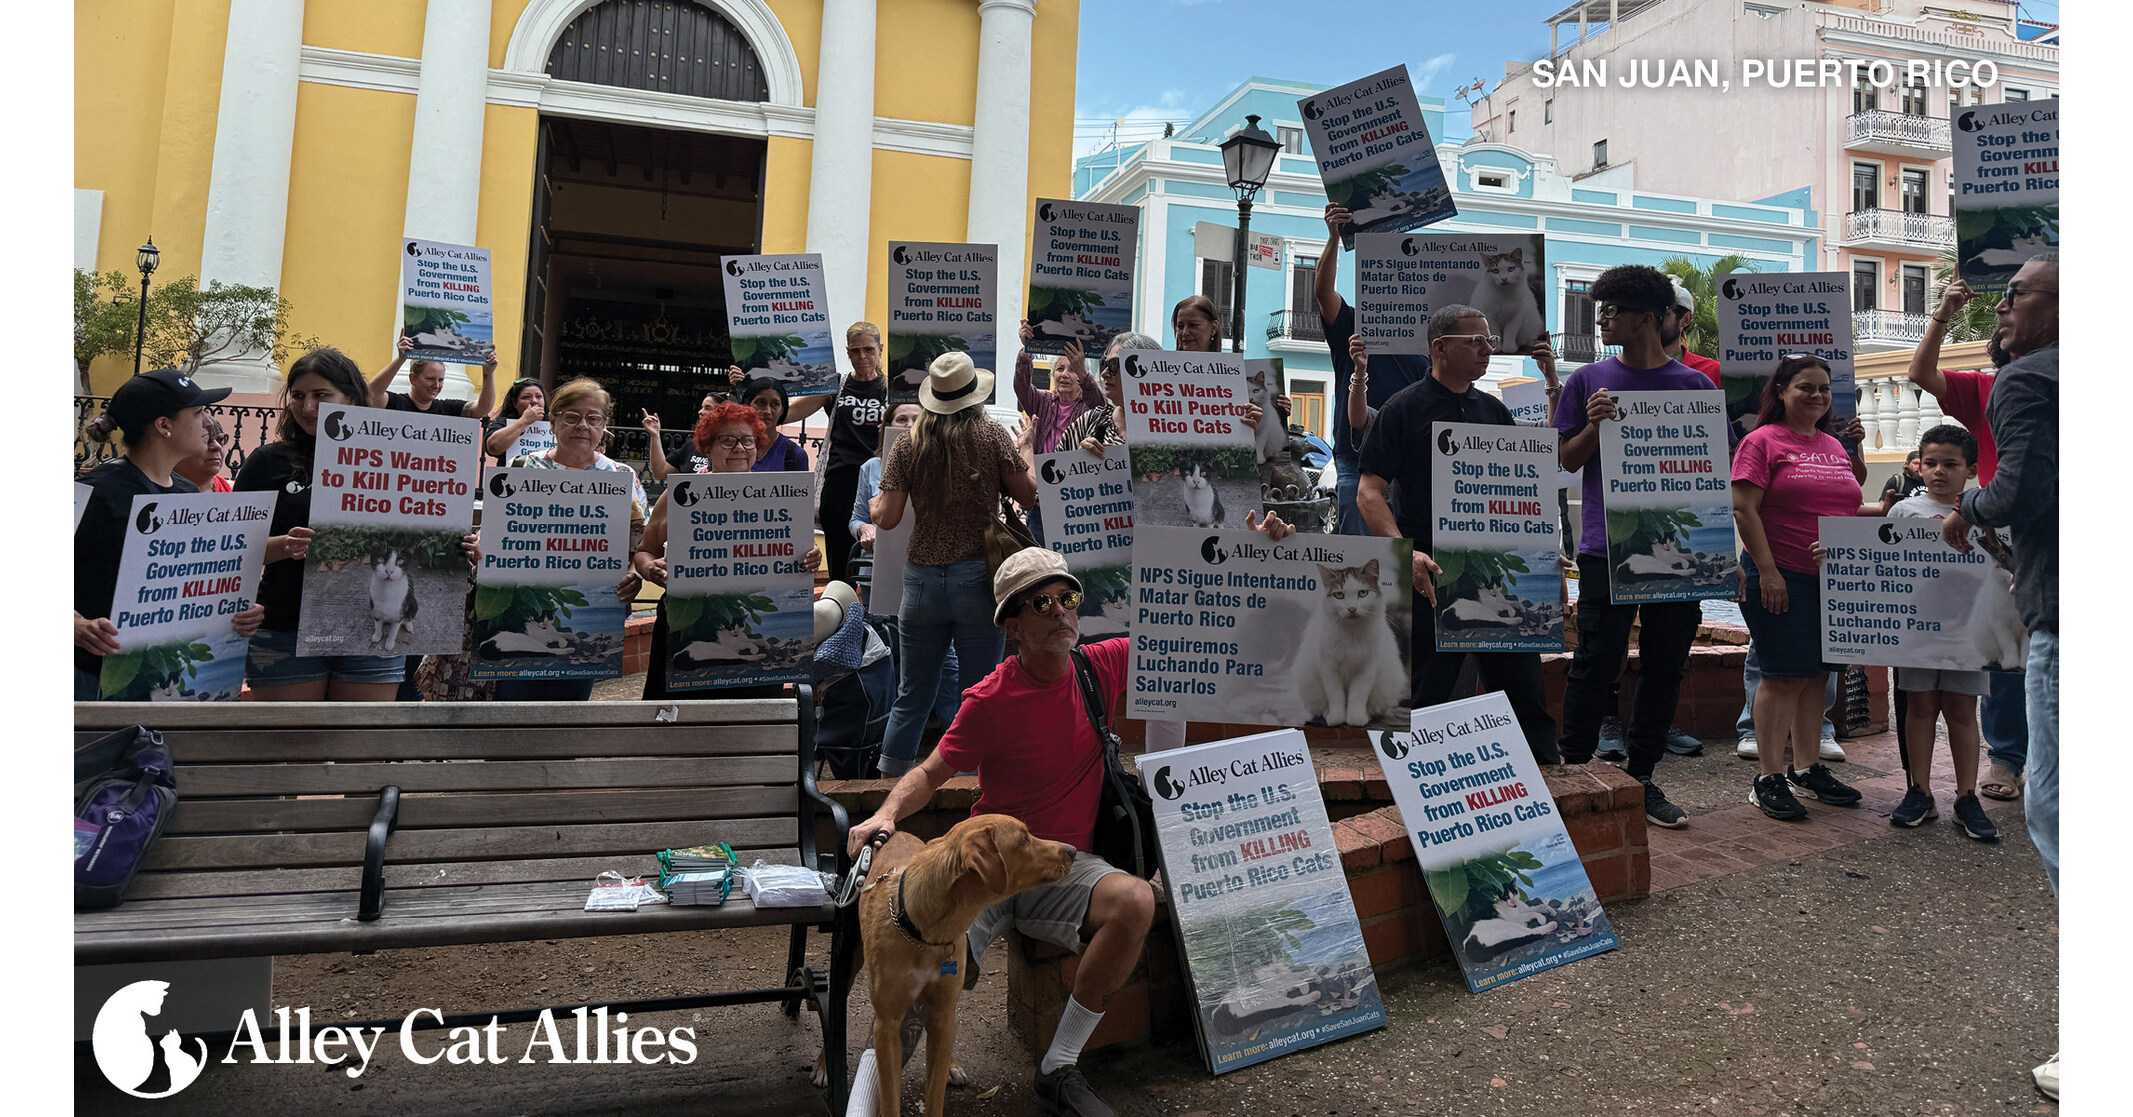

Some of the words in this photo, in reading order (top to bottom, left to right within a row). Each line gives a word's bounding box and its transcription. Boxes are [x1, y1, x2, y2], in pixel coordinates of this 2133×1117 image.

[1326, 94, 1352, 109] Alley
[1354, 87, 1374, 98] Cat
[1375, 77, 1405, 92] Allies
[1321, 114, 1350, 129] Stop
[1351, 107, 1373, 119] the
[1374, 97, 1399, 111] U.S.
[1989, 112, 2028, 126] Alley
[2031, 110, 2059, 121] Cat
[1327, 109, 1402, 141] Government
[1328, 139, 1359, 155] from
[1360, 121, 1408, 144] KILLING
[1977, 134, 2016, 147] Stop
[2021, 131, 2050, 143] the
[1321, 152, 1363, 171] Puerto
[1364, 142, 1393, 157] Rico
[1394, 132, 1423, 146] Cats
[1980, 147, 2059, 162] Governm
[1977, 166, 2018, 178] from
[2024, 161, 2059, 175] KILL
[1962, 181, 2020, 194] Puerto
[1059, 209, 1086, 222] Alley
[1087, 211, 1105, 221] Cat
[1105, 213, 1134, 224] Allies
[1049, 225, 1076, 239] Stop
[1078, 228, 1097, 239] the
[1100, 230, 1120, 241] U.S.
[424, 246, 447, 257] Alley
[447, 249, 463, 258] Cat
[463, 252, 487, 261] Allies
[1050, 239, 1118, 254] Government
[915, 250, 942, 263] Alley
[943, 252, 962, 262] Cat
[963, 253, 992, 263] Allies
[1046, 251, 1073, 263] from
[1076, 254, 1119, 267] KILLING
[417, 259, 440, 270] Stop
[441, 262, 458, 271] the
[460, 264, 478, 273] U.S.
[747, 262, 772, 272] Alley
[773, 261, 790, 270] Cat
[791, 261, 819, 270] Allies
[1035, 264, 1073, 276] Puerto
[1075, 267, 1100, 278] Rico
[1103, 270, 1128, 280] Cats
[419, 269, 477, 283] Government
[905, 268, 933, 282] Stop
[936, 270, 956, 280] the
[958, 270, 980, 281] U.S.
[416, 279, 440, 289] from
[442, 282, 479, 293] KILLING
[739, 279, 766, 290] Stop
[768, 278, 786, 287] the
[788, 277, 809, 286] U.S.
[907, 282, 979, 294] Government
[1748, 283, 1781, 296] Alley
[1783, 283, 1805, 293] Cat
[1807, 282, 1843, 293] Allies
[407, 288, 440, 298] Puerto
[442, 292, 464, 301] Rico
[466, 295, 488, 304] Cats
[743, 289, 810, 300] Government
[903, 296, 933, 307] from
[936, 297, 981, 308] KILLING
[741, 303, 769, 313] from
[771, 301, 813, 312] KILLING
[1737, 303, 1771, 317] Stop
[1774, 303, 1799, 314] the
[1802, 302, 1829, 314] U.S.
[732, 315, 770, 325] Puerto
[772, 314, 797, 323] Rico
[800, 313, 824, 322] Cats
[893, 310, 933, 321] Puerto
[937, 311, 963, 321] Rico
[966, 311, 991, 321] Cats
[1740, 318, 1829, 330] Government
[1737, 334, 1773, 345] from
[1777, 333, 1833, 345] KILLING
[1725, 349, 1774, 361] Puerto
[838, 396, 880, 408] save
[852, 407, 886, 426] gat
[1511, 406, 1531, 417] NPS
[1533, 404, 1548, 413] Sig
[357, 420, 399, 440] Alley
[401, 425, 427, 440] Cat
[429, 428, 472, 444] Allies
[527, 427, 548, 436] Alley
[520, 439, 541, 448] Stop
[337, 447, 383, 467] NPS
[390, 451, 457, 473] Wants
[321, 469, 344, 487] to
[352, 471, 390, 490] Kill
[396, 474, 467, 495] Puerto
[341, 493, 391, 513] Rico
[399, 496, 446, 516] Cats
[1233, 544, 1270, 562] Alley
[1273, 545, 1298, 560] Cat
[1301, 547, 1344, 563] Allies
[1140, 567, 1173, 584] NPS
[1177, 569, 1224, 588] Sigue
[1227, 571, 1316, 591] Intentando
[1139, 588, 1189, 604] Matar
[1194, 590, 1241, 607] Gatos
[1246, 593, 1266, 608] de
[1138, 608, 1193, 625] Puerto
[1199, 611, 1235, 628] Rico
[1137, 635, 1238, 655] Seguiremos
[1478, 641, 1513, 649] alleycat.org
[1828, 647, 1865, 655] alleycat.org
[1136, 655, 1219, 674] Luchando
[1226, 659, 1263, 676] Para
[1135, 675, 1216, 694] Salvarlos
[1134, 698, 1177, 708] alleycat.org
[1411, 728, 1444, 747] Alley
[1446, 722, 1473, 737] Cat
[1474, 714, 1512, 732] Allies
[1407, 759, 1447, 779] Stop
[1447, 752, 1476, 768] the
[1476, 742, 1509, 761] U.S.
[1418, 762, 1516, 799] Government
[1423, 802, 1465, 822] from
[1464, 782, 1528, 811] KILLING
[1417, 823, 1473, 847] Puerto
[1474, 813, 1512, 832] Rico
[1513, 802, 1550, 821] Cats
[1474, 976, 1496, 988] Learn
[1497, 968, 1518, 980] more:
[1518, 954, 1559, 974] alleycat.org
[1563, 937, 1614, 958] #SaveSanJuanCats
[1217, 1050, 1242, 1064] Learn
[1244, 1043, 1268, 1056] more:
[1269, 1029, 1315, 1049] alleycat.org
[1321, 1011, 1381, 1033] #SaveSanJuanCats
